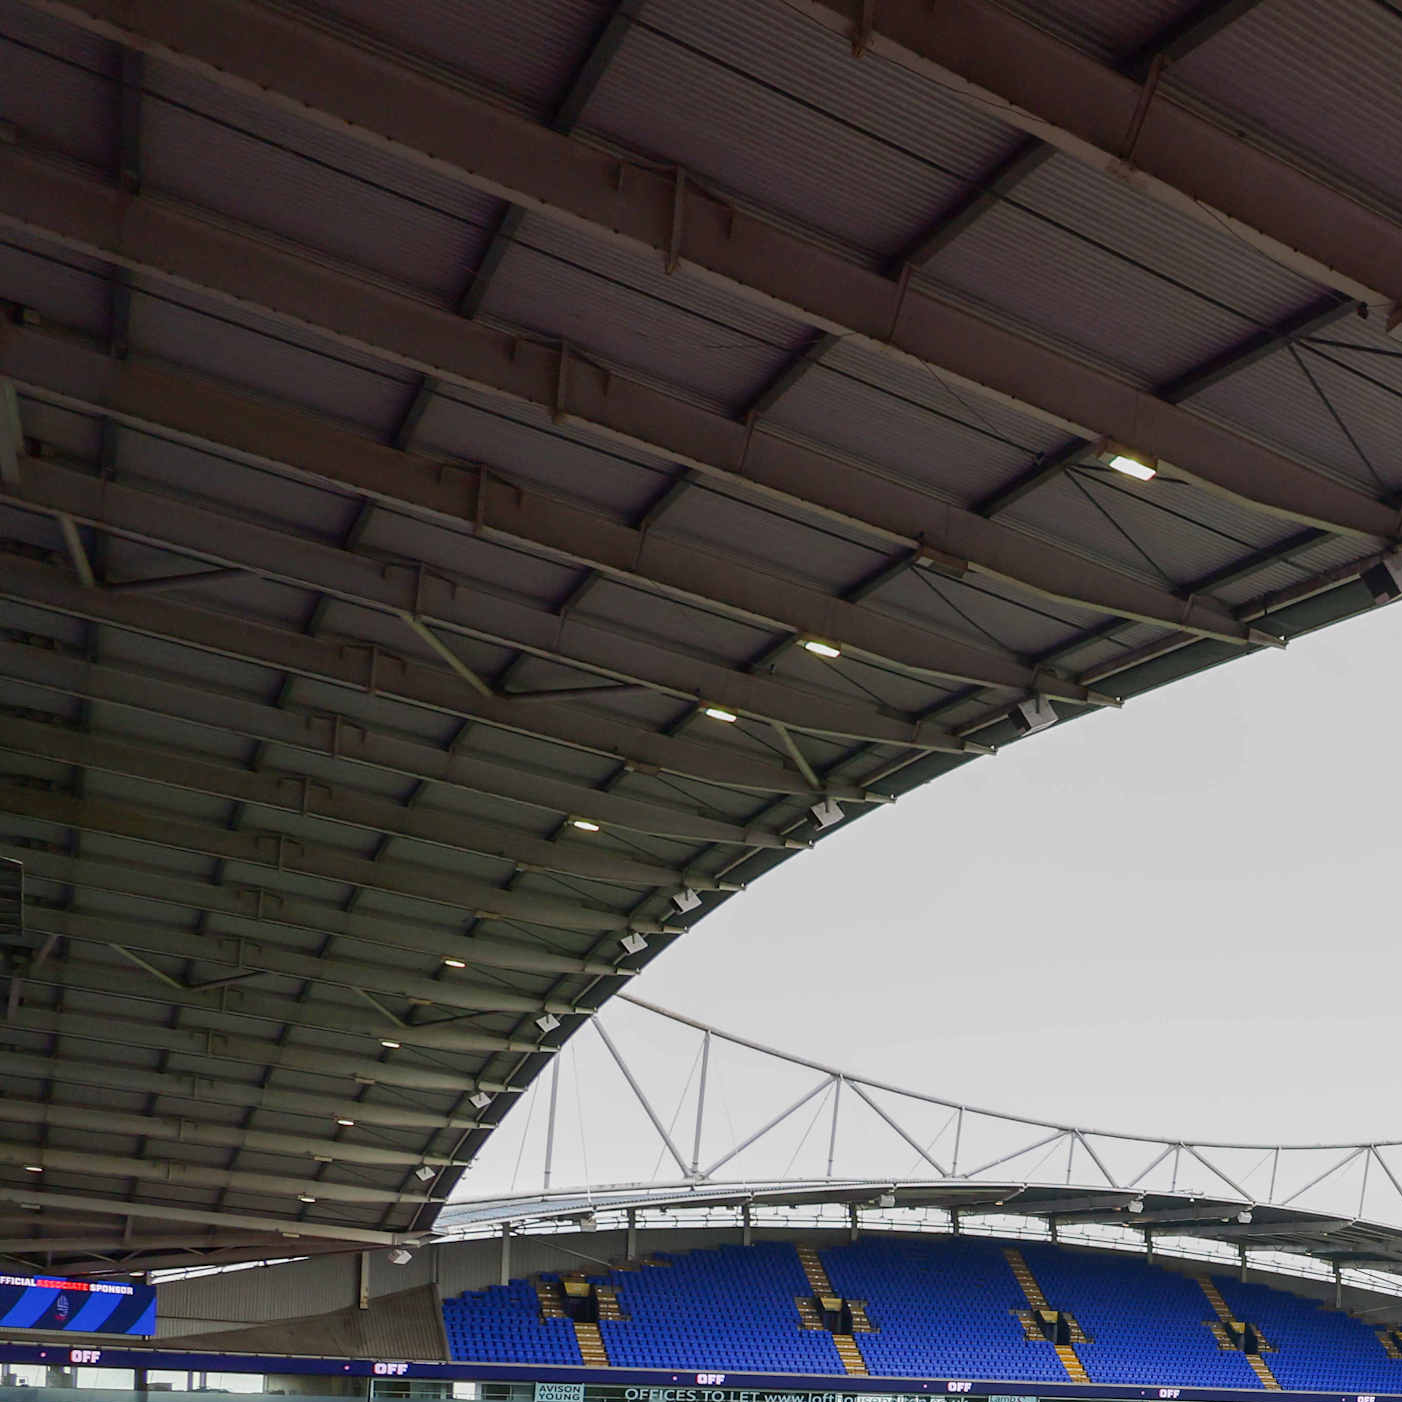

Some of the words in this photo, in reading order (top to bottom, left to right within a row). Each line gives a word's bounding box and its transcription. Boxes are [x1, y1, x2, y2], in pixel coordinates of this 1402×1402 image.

[0, 1276, 36, 1287] FFICIAL
[89, 1285, 134, 1295] SPONSOR
[70, 1350, 101, 1363] OFF
[373, 1363, 409, 1375] OFF
[696, 1374, 726, 1385] OFF
[539, 1385, 581, 1394] AVISON
[947, 1382, 972, 1392] OFF
[538, 1393, 580, 1401] YOUNG
[625, 1388, 697, 1402] OFFICES
[702, 1391, 724, 1402] TO
[731, 1392, 760, 1402] LET
[1158, 1389, 1181, 1399] OFF
